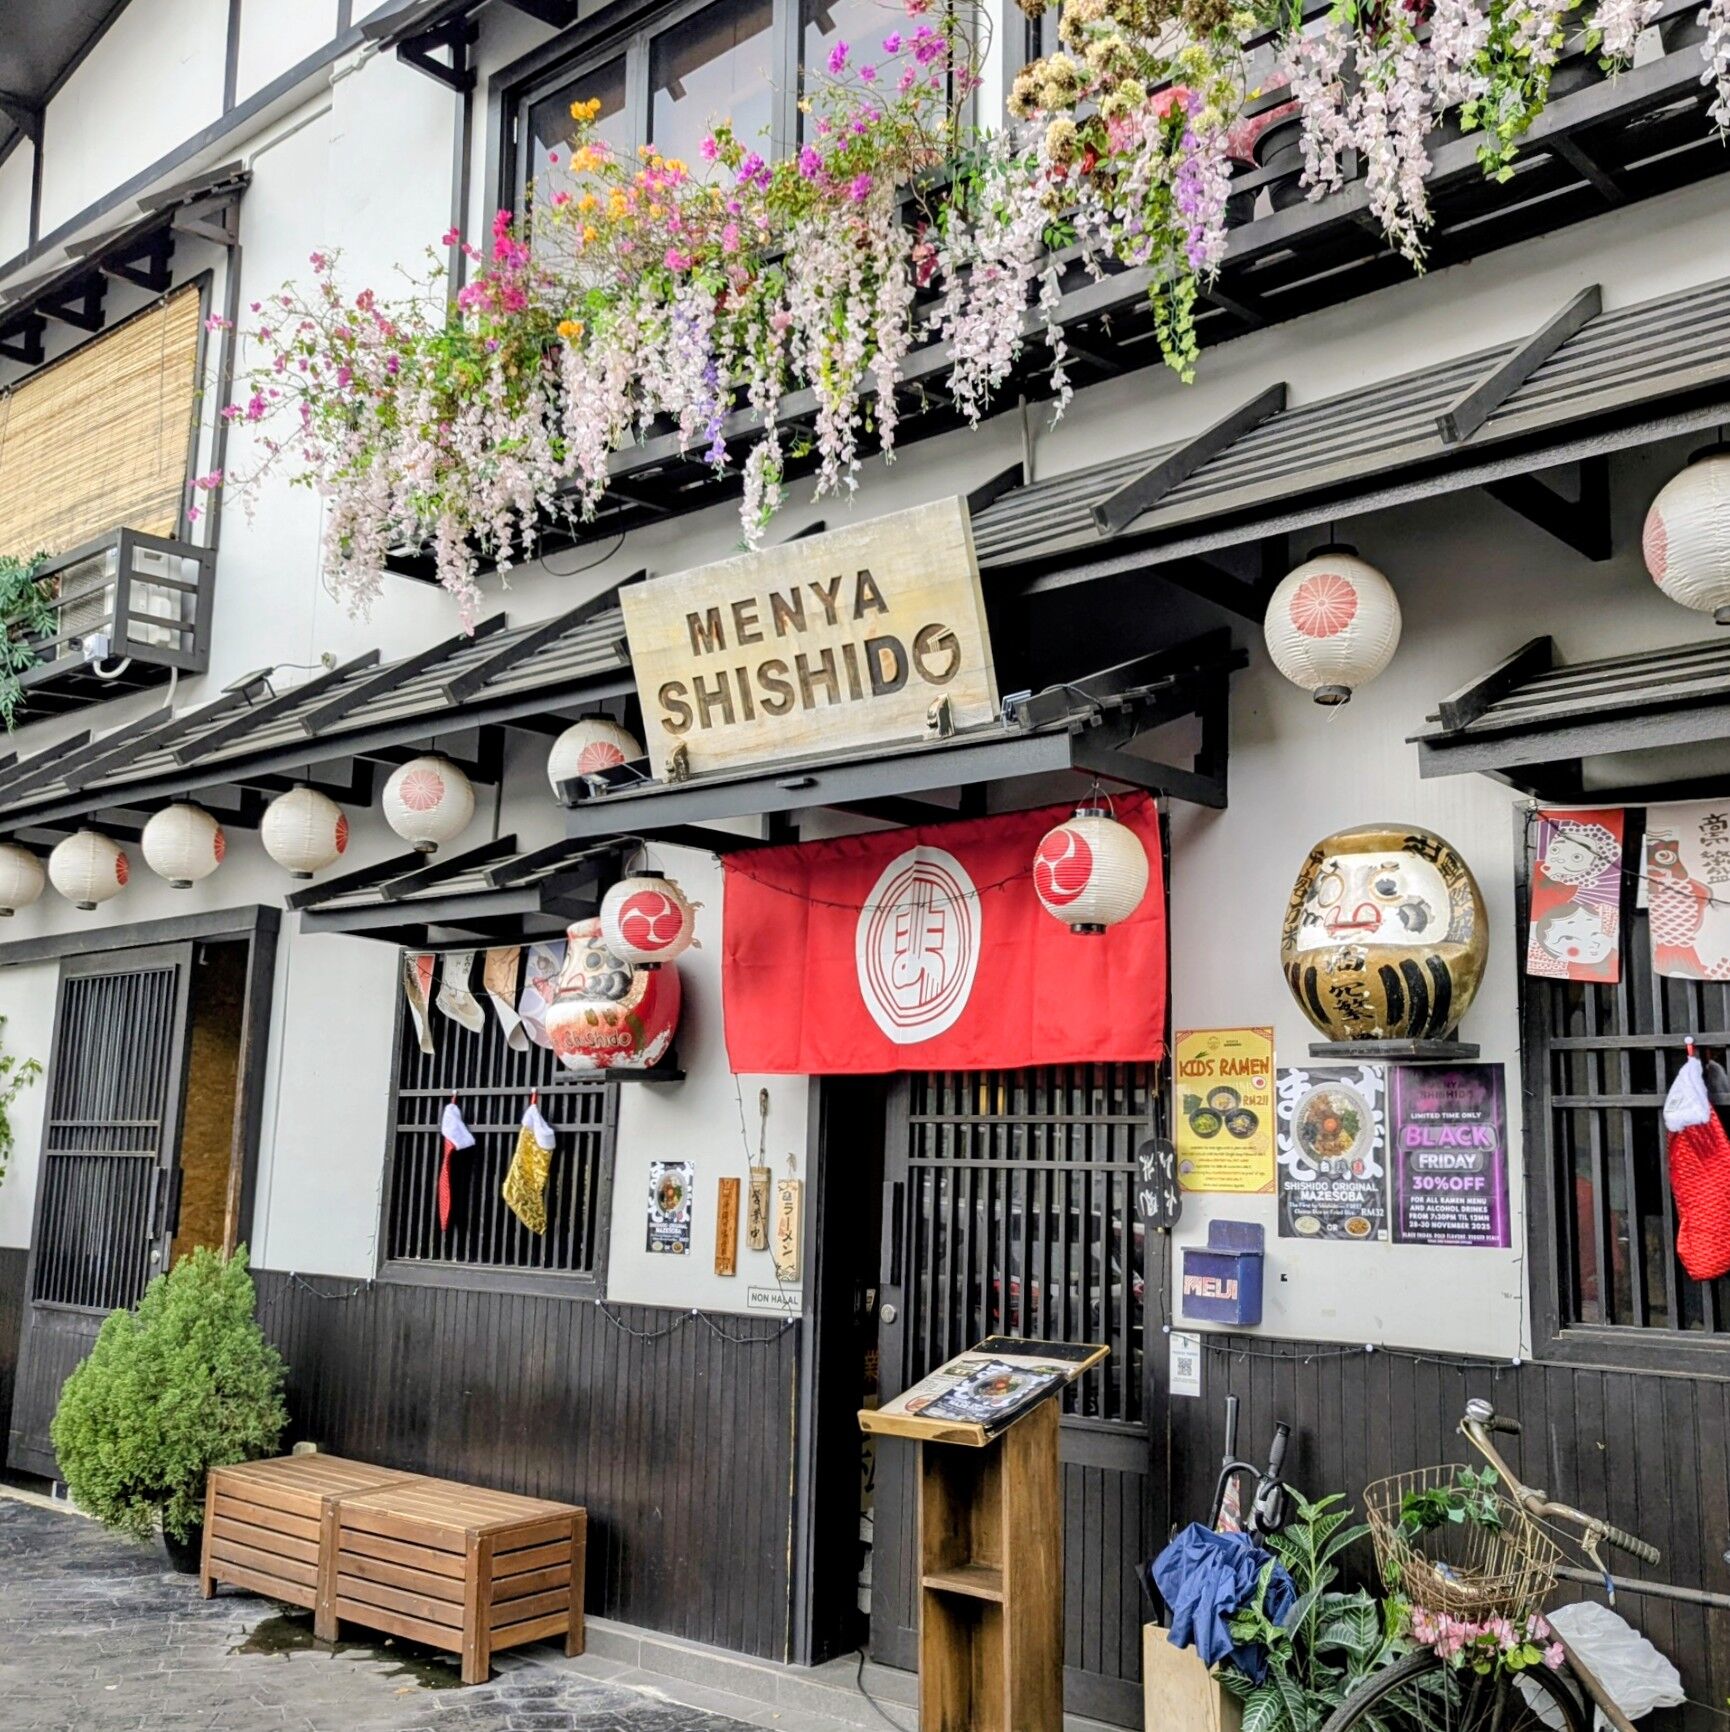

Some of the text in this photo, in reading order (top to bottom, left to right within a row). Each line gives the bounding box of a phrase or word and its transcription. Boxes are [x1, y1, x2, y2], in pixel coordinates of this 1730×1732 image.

[686, 568, 889, 657] MENYA
[658, 623, 962, 735] SHISHIDO
[1179, 1056, 1269, 1077] KIDS RAMEN
[1406, 1124, 1490, 1147] BLACK
[1419, 1153, 1476, 1169] FRIDAY
[1284, 1181, 1379, 1191] SHISHIDO ORIGINAL
[1412, 1176, 1485, 1190] 30%OFF
[1301, 1191, 1365, 1201] MAZESOBA
[1361, 1208, 1384, 1216] RM32
[751, 1293, 798, 1304] NON HALAL
